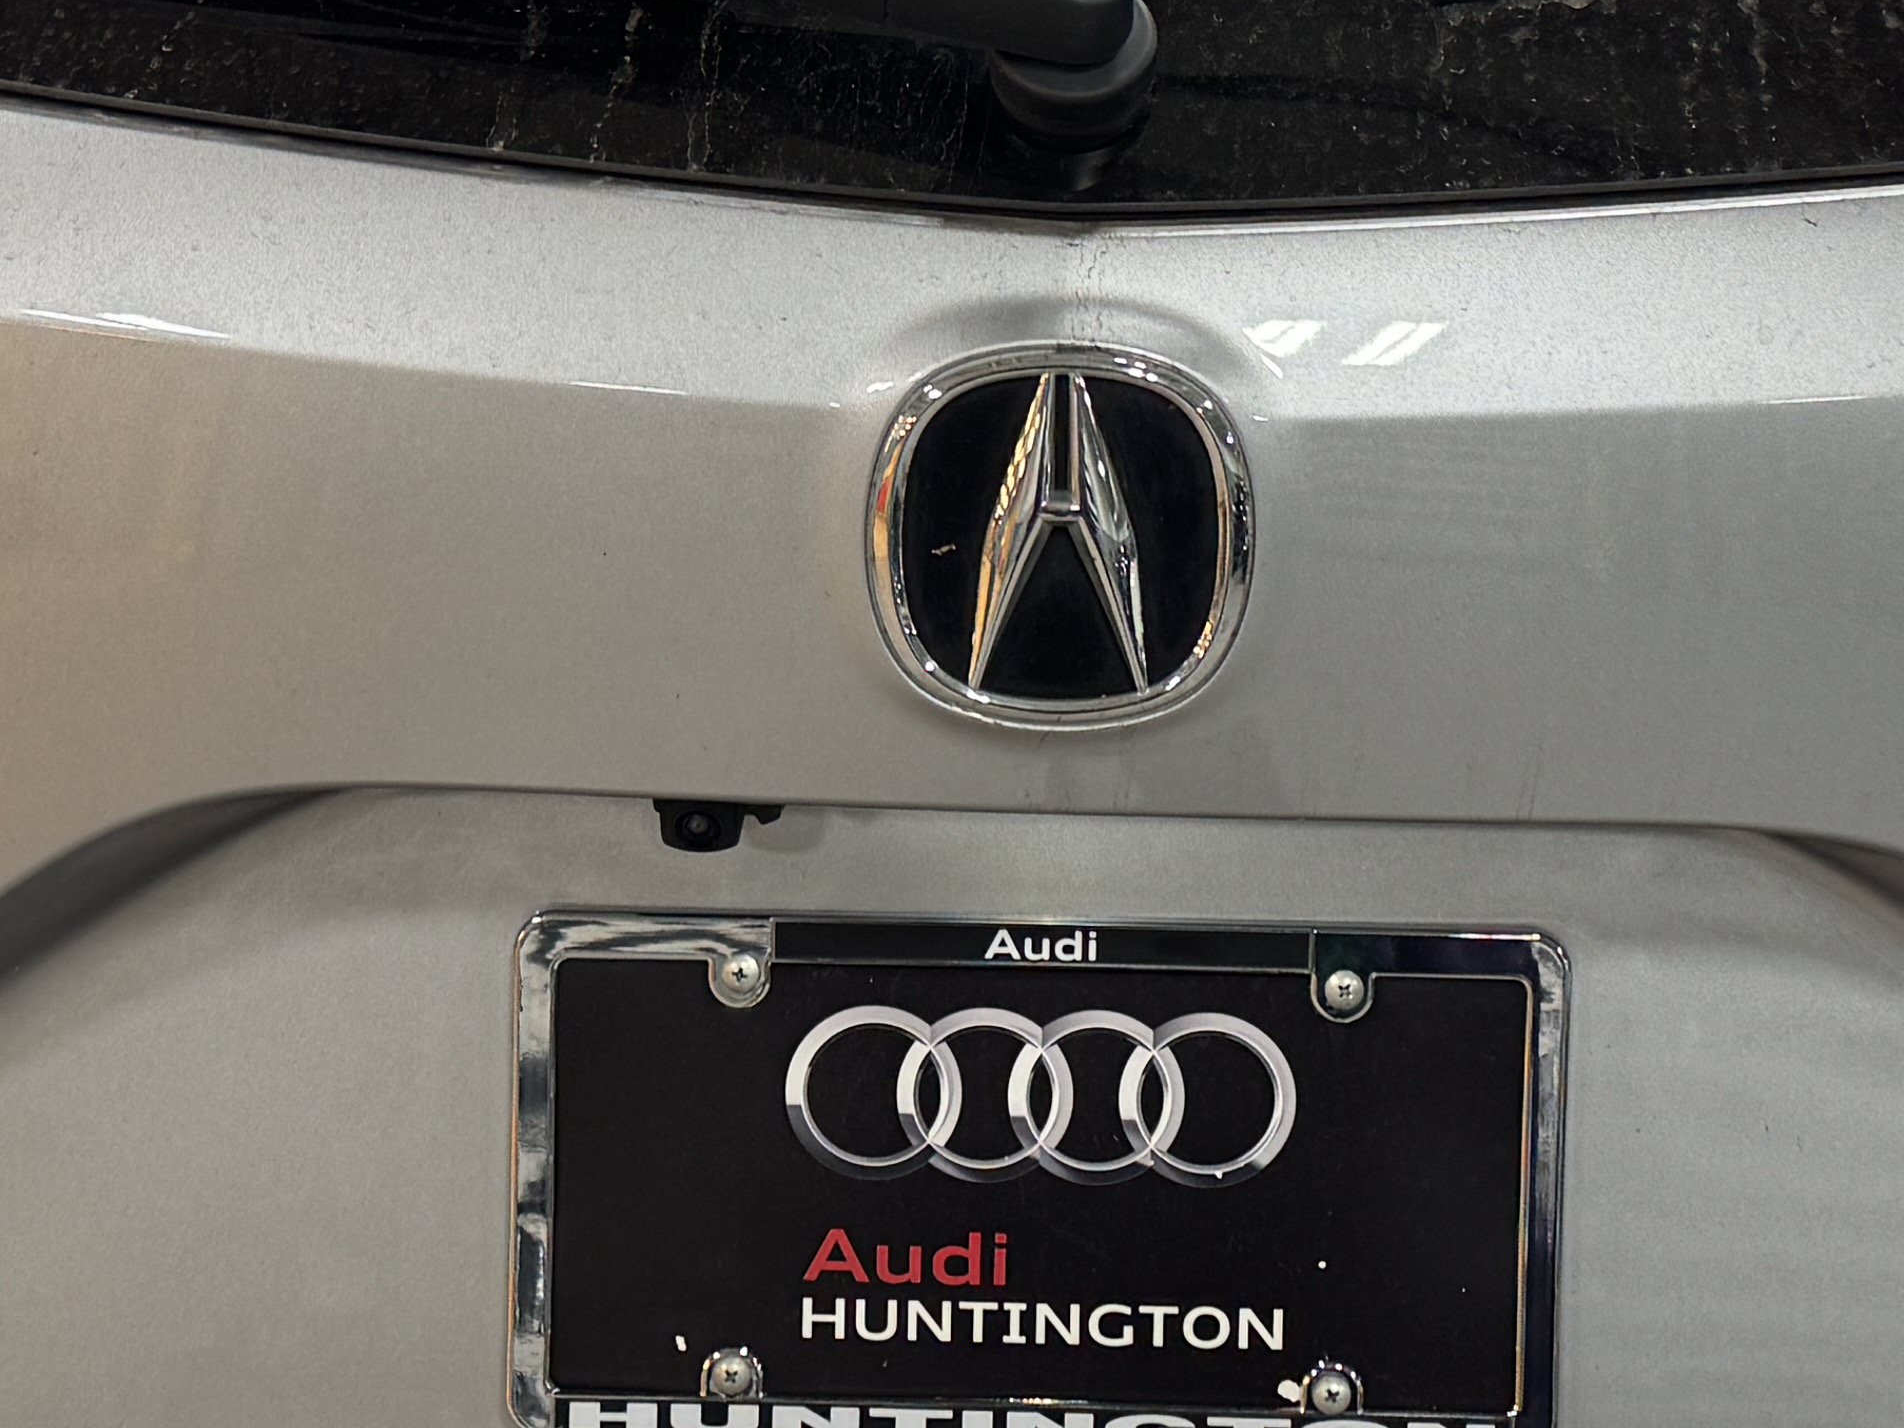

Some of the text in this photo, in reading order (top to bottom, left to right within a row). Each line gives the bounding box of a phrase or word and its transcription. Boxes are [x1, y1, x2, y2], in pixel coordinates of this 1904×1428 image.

[984, 928, 1098, 963] Audi
[802, 1228, 1009, 1287] Audi
[800, 1297, 1285, 1352] HUNTINGTON
